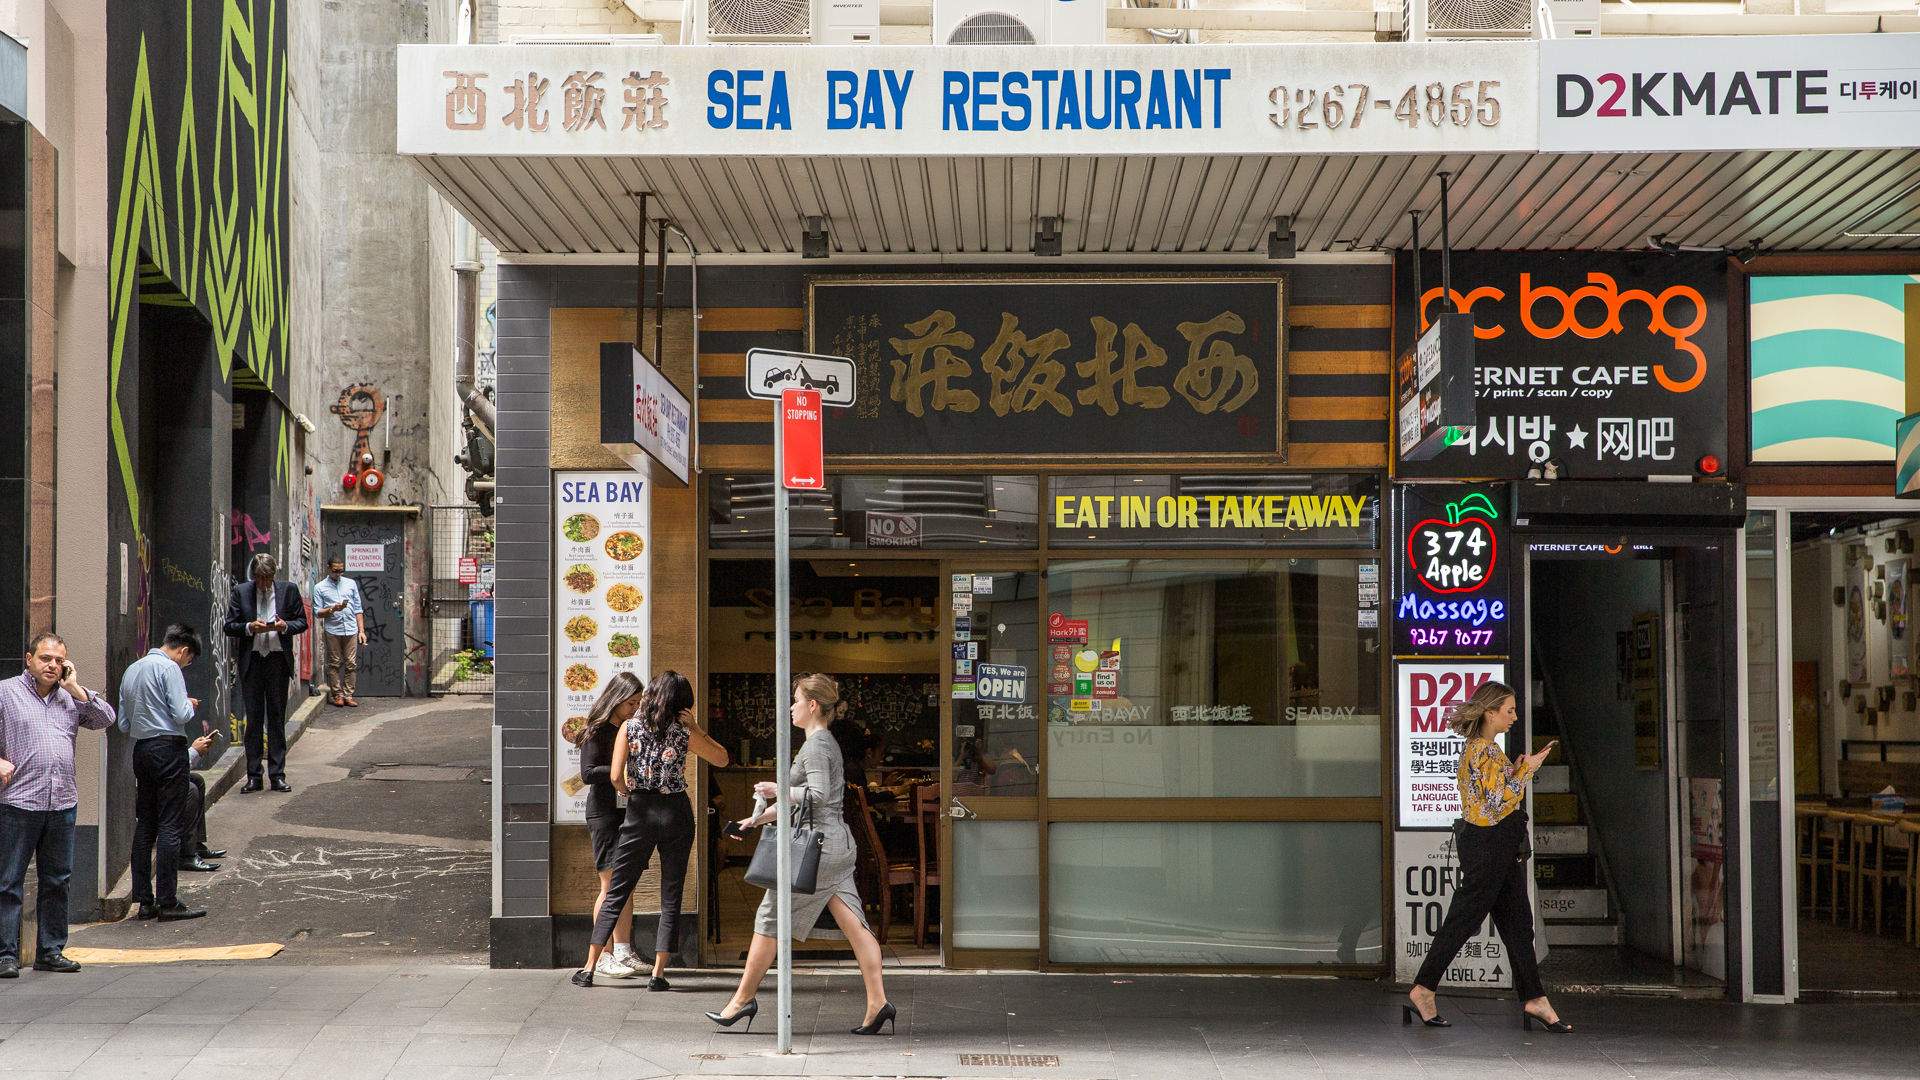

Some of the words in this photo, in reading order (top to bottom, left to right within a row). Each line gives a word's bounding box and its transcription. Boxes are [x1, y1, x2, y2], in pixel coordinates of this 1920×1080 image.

[706, 70, 792, 131] SEA
[826, 69, 914, 131] BAY
[942, 68, 1231, 131] RESTAURANT
[1556, 70, 1829, 118] D2KMATE
[1840, 80, 1917, 101] 디투케이
[442, 70, 670, 132] 西北飯莊
[1268, 80, 1502, 131] 9267-4855
[1572, 366, 1649, 386] CAFE
[796, 396, 808, 406] NO
[1493, 388, 1524, 398] print
[1537, 389, 1568, 398] scan
[1581, 389, 1613, 399] copy
[787, 409, 818, 421] STOPPING
[1597, 417, 1675, 461] 网吧
[562, 482, 600, 503] SEA
[606, 482, 644, 503] BAY
[1056, 495, 1114, 528] EAT
[1120, 495, 1151, 528] IN
[1157, 495, 1199, 528] OR
[1205, 495, 1367, 528] TAKEAWAY
[870, 518, 895, 534] NO
[869, 537, 918, 547] SMOKING
[1423, 527, 1487, 556] 374
[1425, 556, 1483, 587] Apple
[1398, 592, 1505, 626] Massage
[1410, 628, 1448, 645] 9267
[1454, 628, 1493, 645] 9077
[981, 666, 999, 676] YES,
[1000, 668, 1012, 676] We
[979, 677, 1025, 699] OPEN
[1285, 706, 1356, 721] SEABAY
[1411, 783, 1455, 792] BUSINESS
[1411, 793, 1458, 801] LANGUAGE
[1412, 804, 1433, 812] TAFE
[1435, 804, 1442, 812] &
[1446, 968, 1476, 982] LEVEL
[1478, 968, 1486, 982] 2
